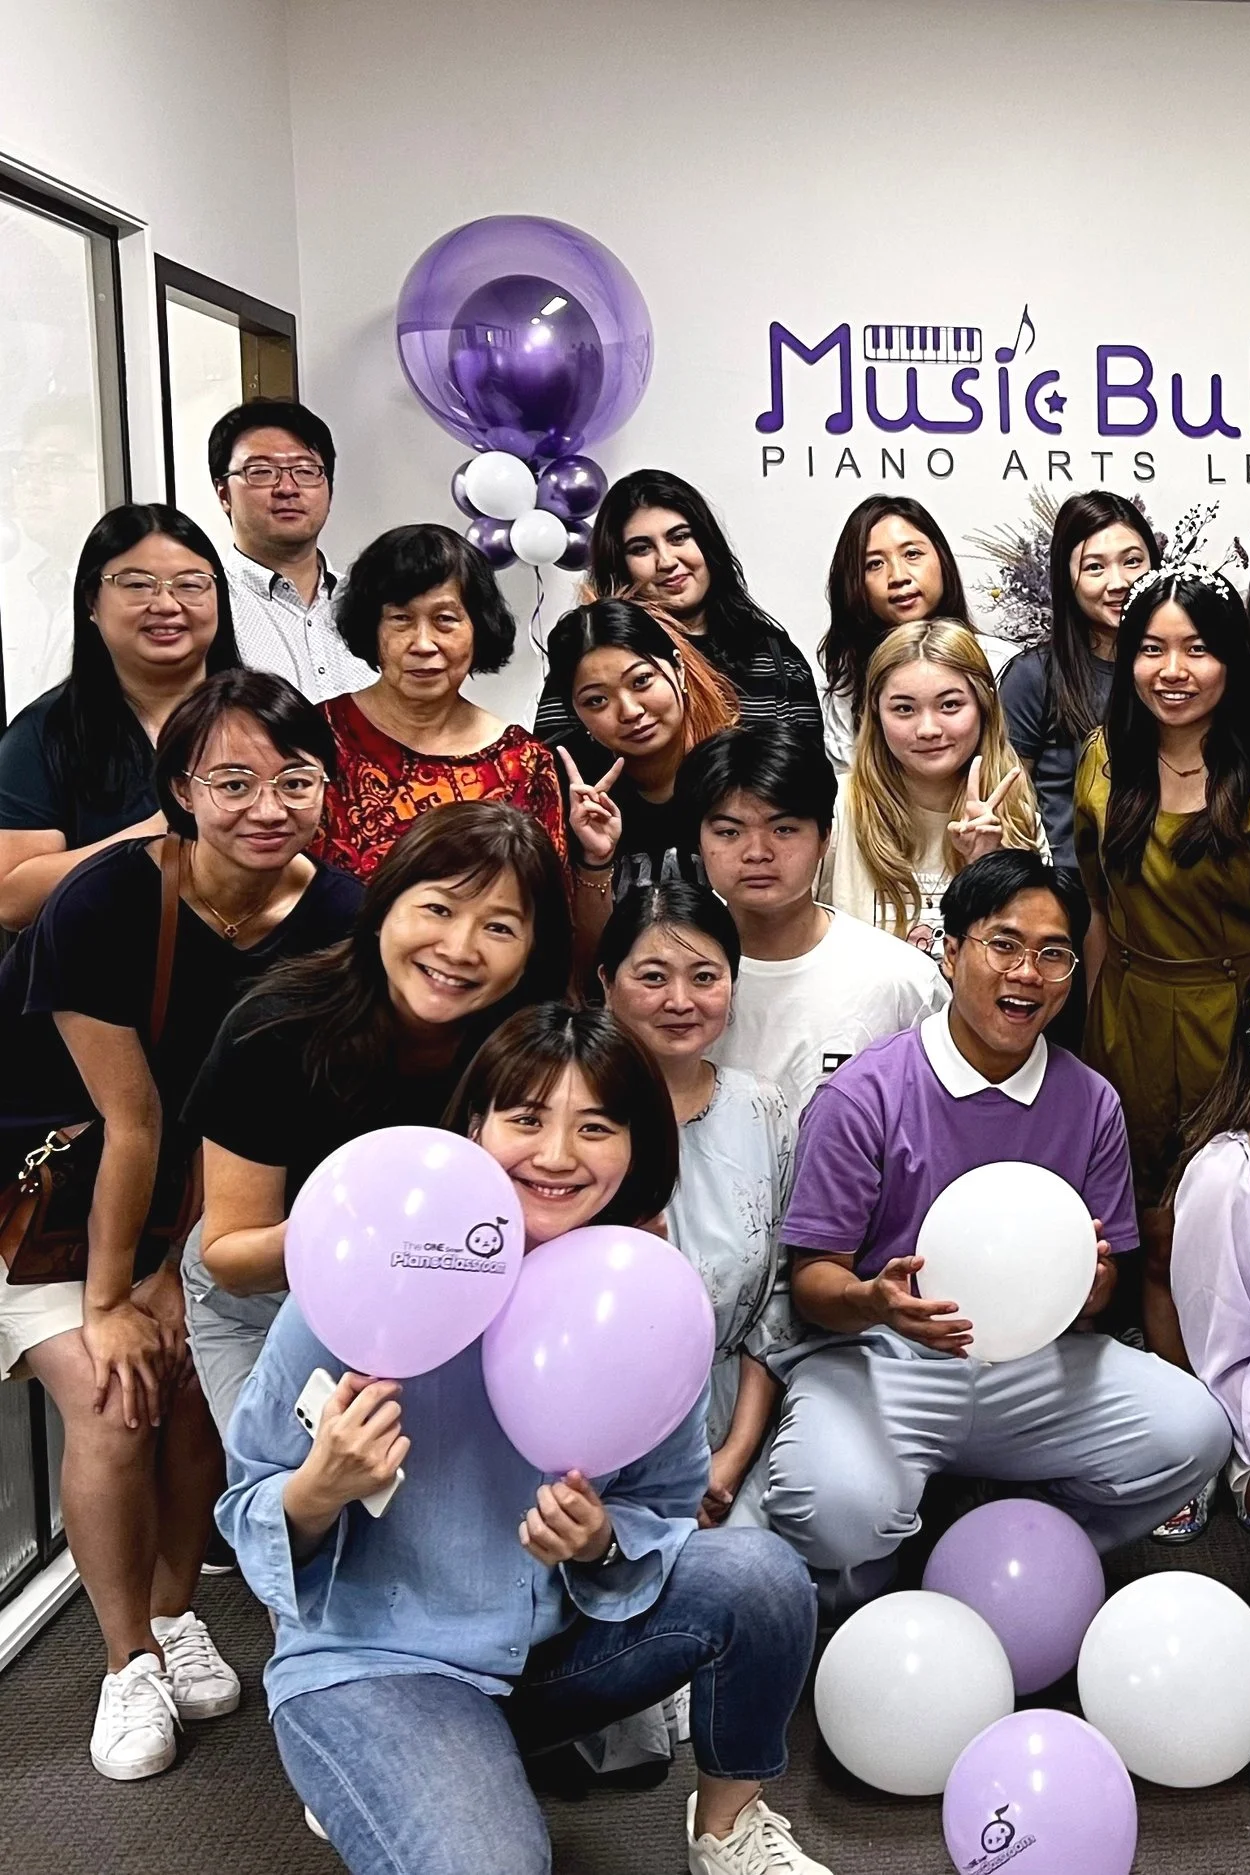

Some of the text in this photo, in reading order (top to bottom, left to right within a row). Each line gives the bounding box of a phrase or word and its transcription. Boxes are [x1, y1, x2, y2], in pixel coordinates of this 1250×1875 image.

[755, 304, 1066, 435] Music
[761, 446, 956, 480] PIANO
[1003, 449, 1158, 482] ARTS
